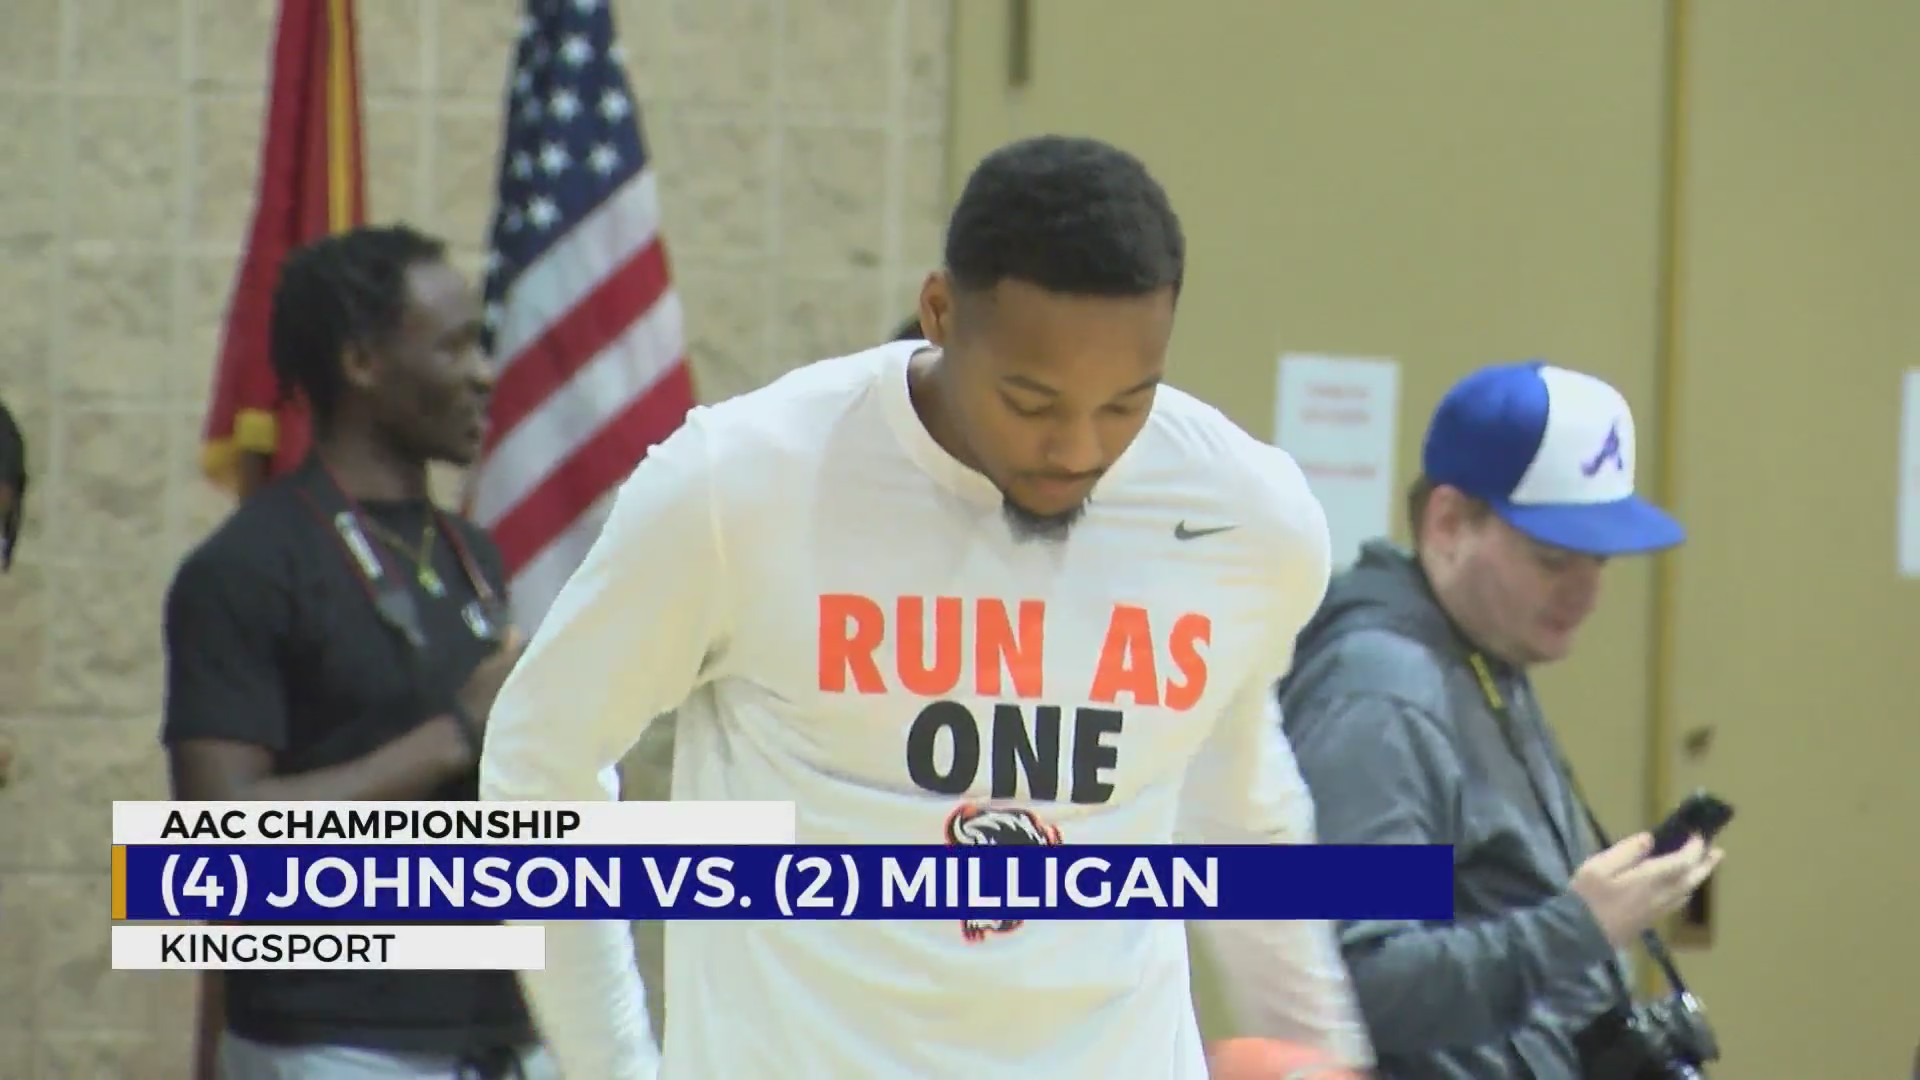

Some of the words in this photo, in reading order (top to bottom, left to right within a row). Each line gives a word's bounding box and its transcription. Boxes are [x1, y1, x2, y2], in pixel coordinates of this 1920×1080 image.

[1581, 422, 1624, 478] A
[817, 593, 1046, 698] RUN
[1089, 603, 1212, 711] AS
[906, 700, 1124, 804] ONE
